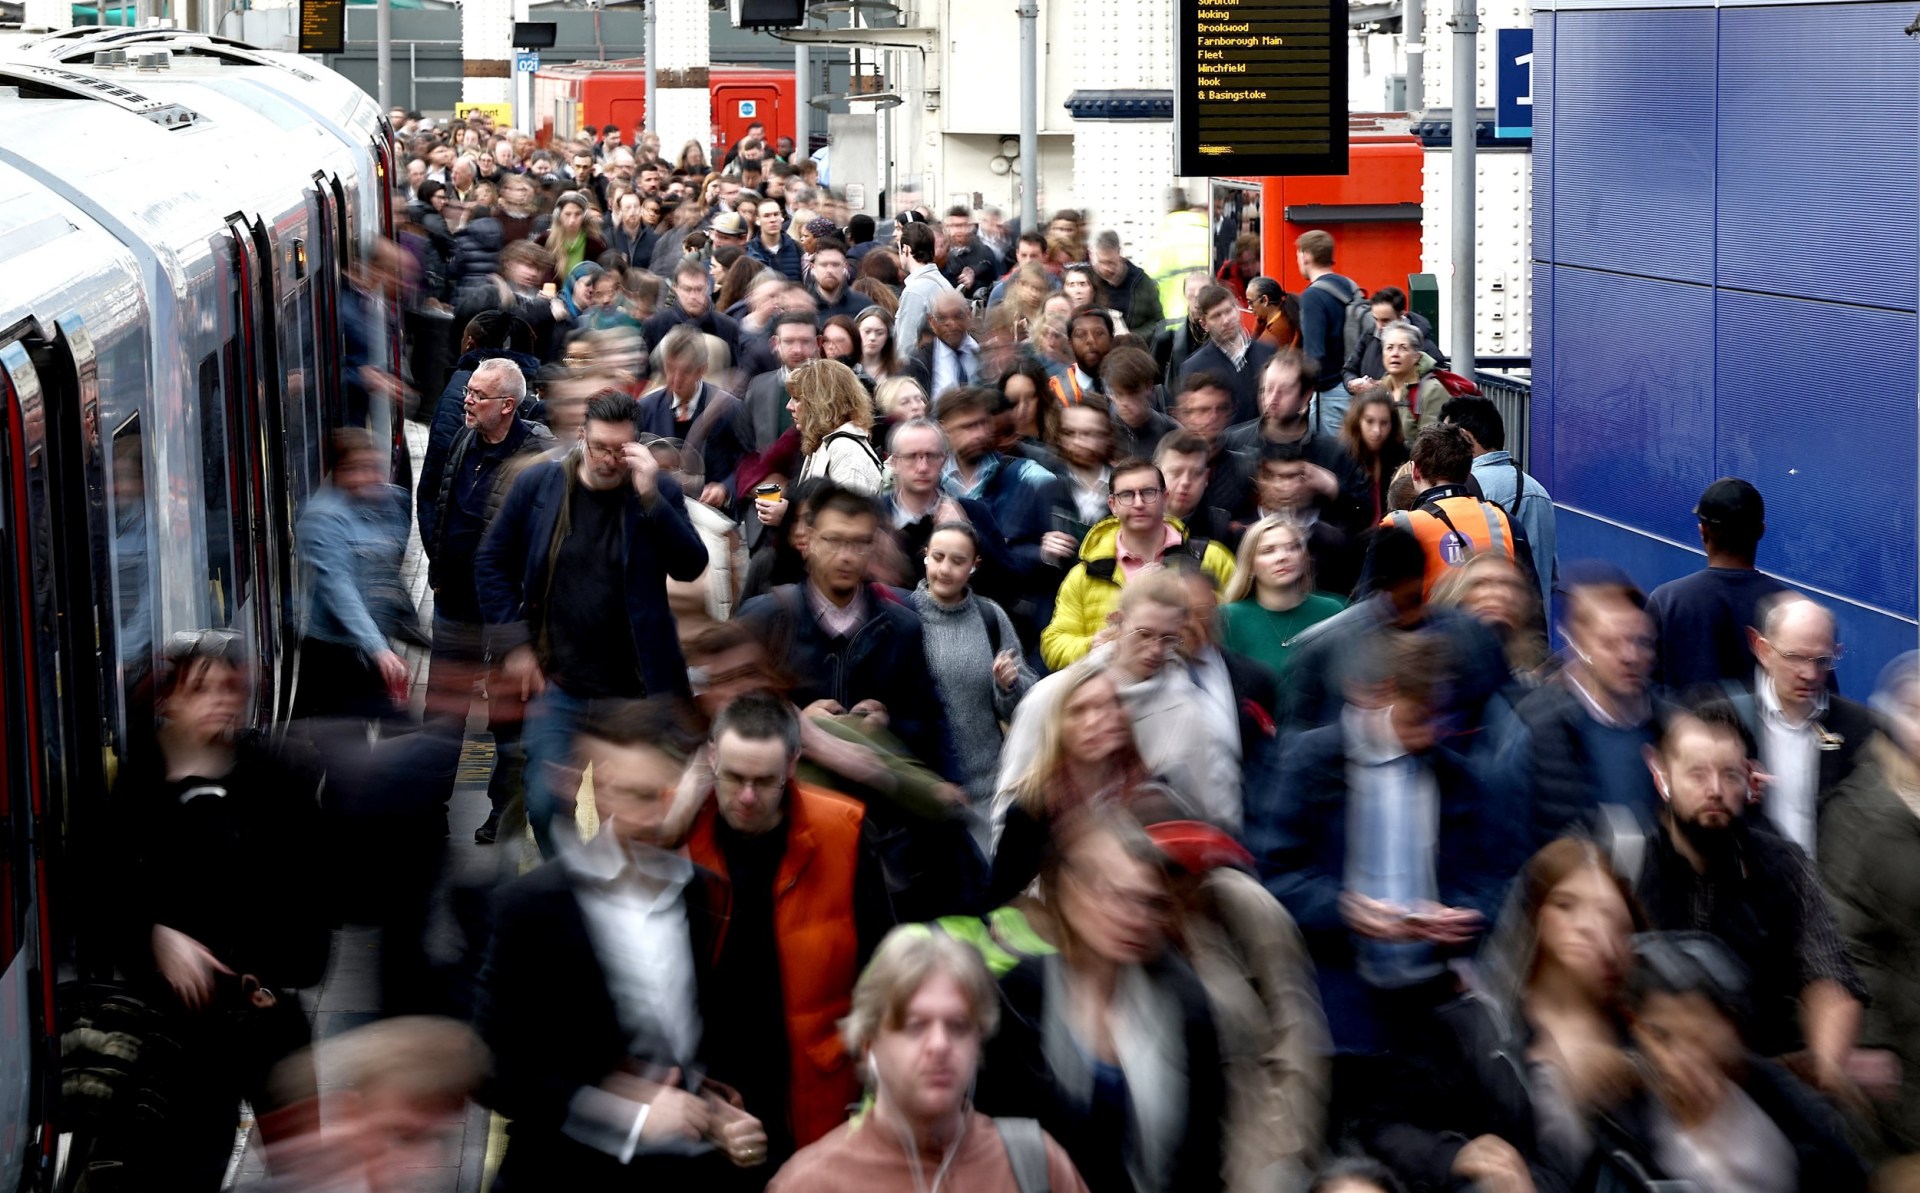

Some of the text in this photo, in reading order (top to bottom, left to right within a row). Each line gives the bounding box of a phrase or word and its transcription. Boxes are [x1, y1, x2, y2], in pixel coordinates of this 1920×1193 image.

[1198, 10, 1230, 20] Woking
[1198, 23, 1249, 32] Brookwood
[1198, 36, 1283, 47] Farnborough Main
[1198, 50, 1223, 59] Fleet
[1198, 63, 1246, 72] Winchfield
[1198, 77, 1221, 86] Hook
[1198, 91, 1267, 101] & Basingstoke
[479, 109, 499, 117] ront
